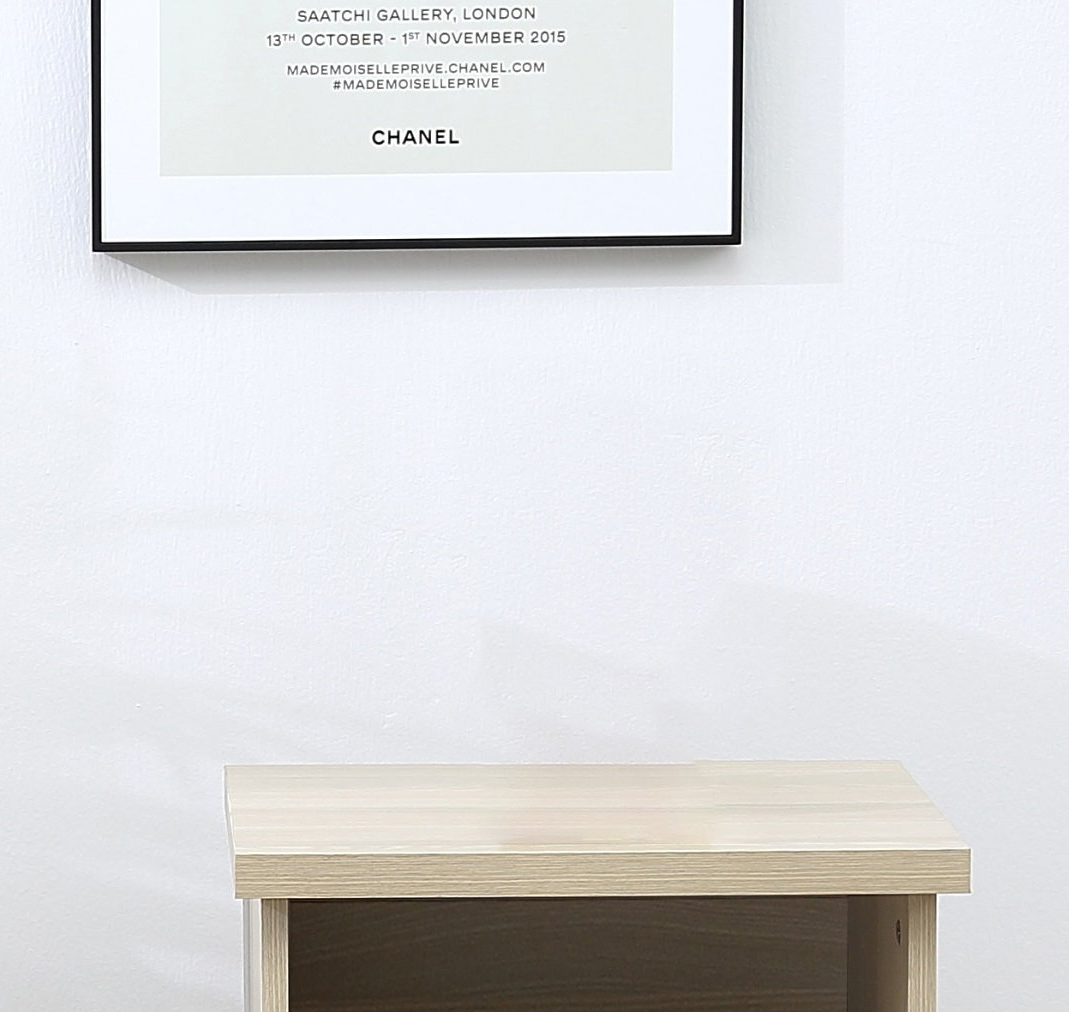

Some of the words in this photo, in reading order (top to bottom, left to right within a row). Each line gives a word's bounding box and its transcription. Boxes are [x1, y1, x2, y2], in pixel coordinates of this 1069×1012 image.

[297, 9, 371, 22] SAATCHI
[377, 8, 457, 22] GALLERY,
[463, 7, 536, 20] LONDON
[267, 33, 296, 47] 13TH
[301, 33, 384, 46] OCTOBER
[426, 31, 524, 45] NOVEMBER
[530, 30, 566, 44] 2015
[287, 62, 545, 76] MADEMOISELLEPRIVE.CHANEL.COM
[333, 77, 499, 90] #MADEMOISELLEPRIVE
[371, 129, 460, 146] CHANEL
